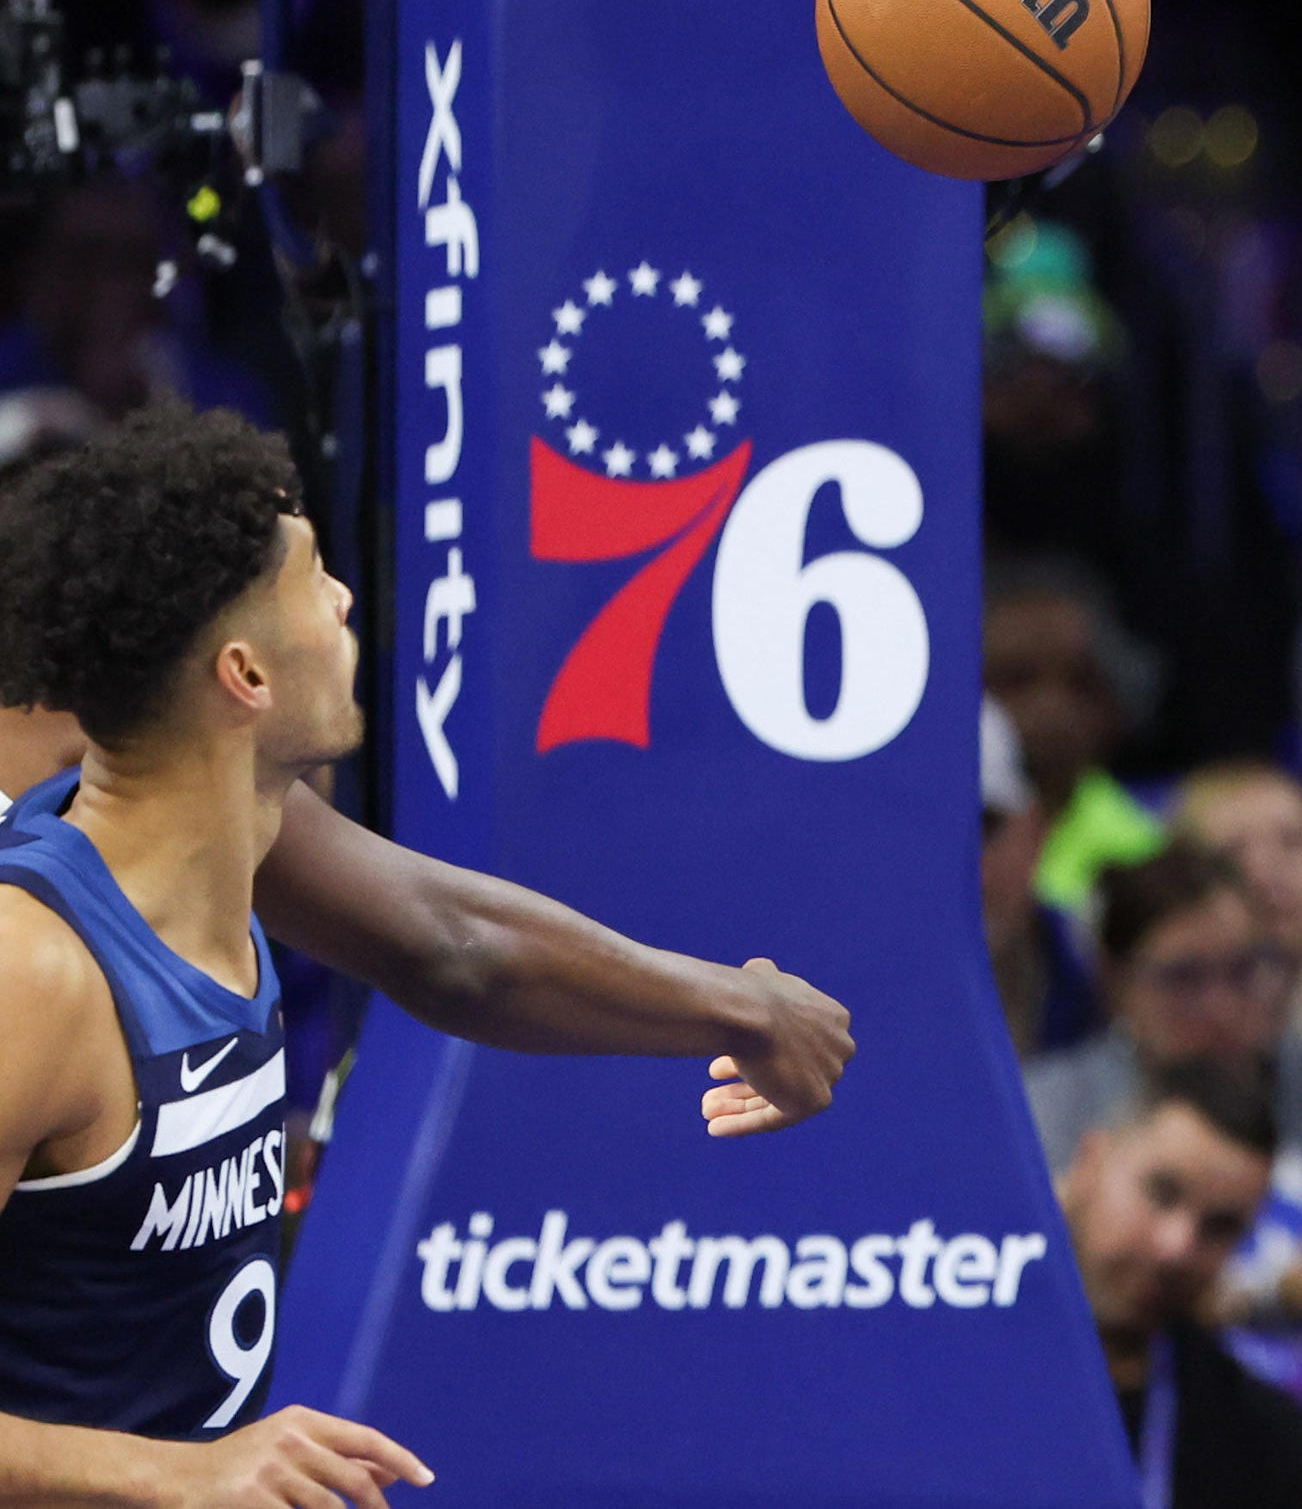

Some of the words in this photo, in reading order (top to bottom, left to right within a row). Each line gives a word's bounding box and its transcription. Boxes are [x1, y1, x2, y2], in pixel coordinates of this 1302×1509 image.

[529, 433, 931, 763] 76
[130, 1122, 287, 1251] MINNES
[417, 1209, 1047, 1312] ticketmaster
[202, 1256, 278, 1429] 9
